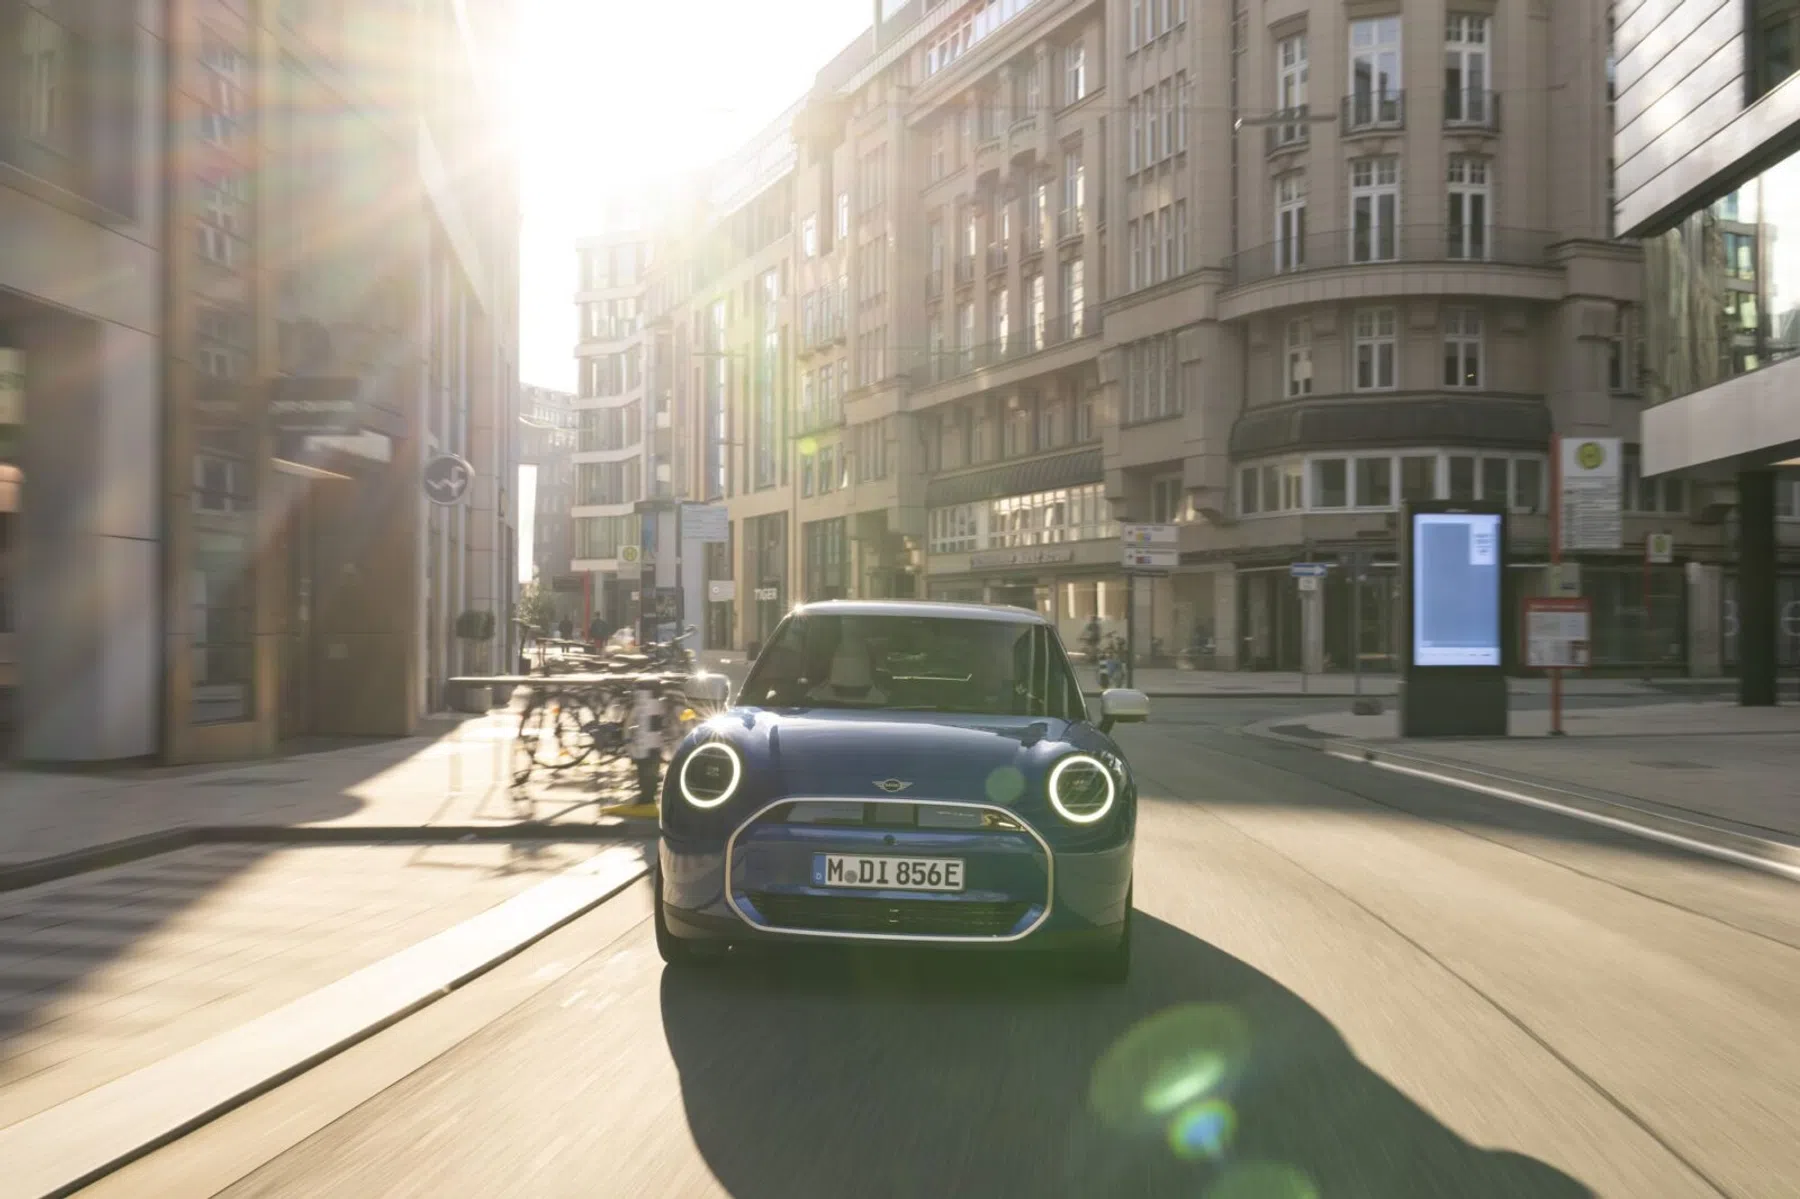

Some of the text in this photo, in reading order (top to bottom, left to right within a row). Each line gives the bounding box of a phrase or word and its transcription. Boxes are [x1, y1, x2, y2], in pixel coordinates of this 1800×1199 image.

[754, 588, 778, 601] TIGER
[827, 858, 960, 887] M DI 856E
